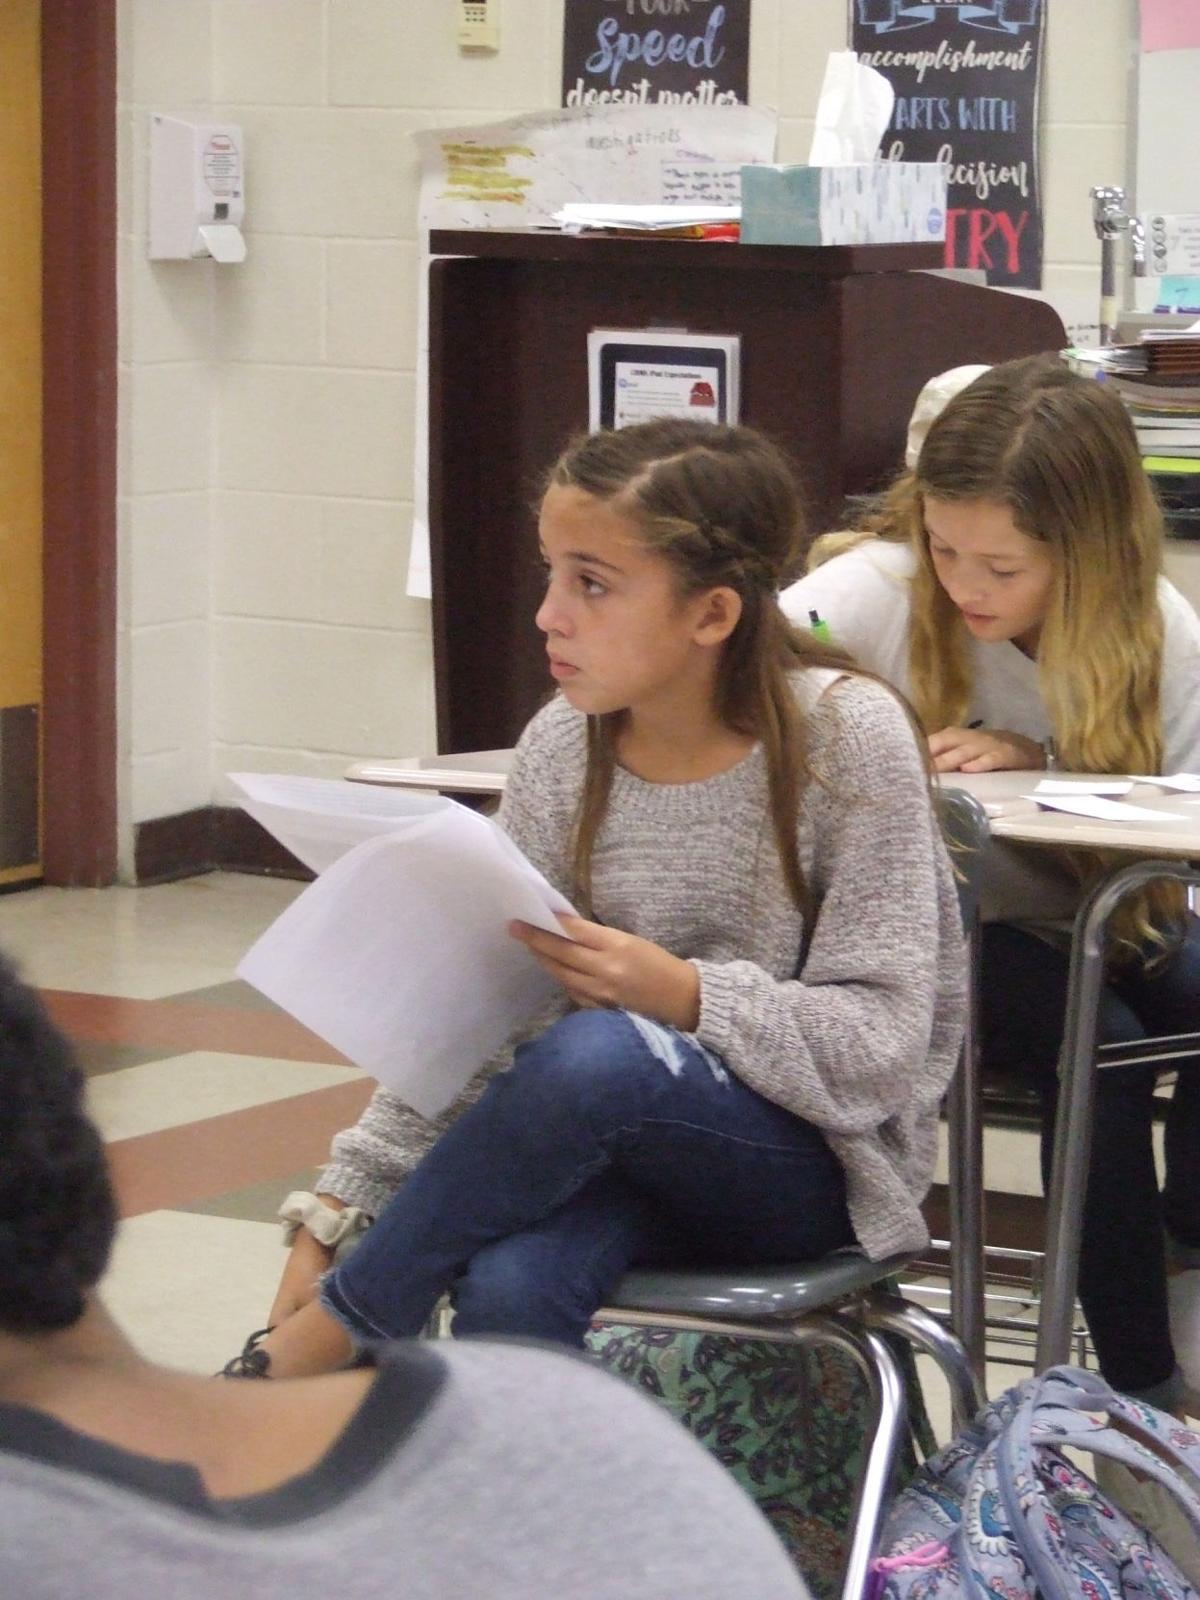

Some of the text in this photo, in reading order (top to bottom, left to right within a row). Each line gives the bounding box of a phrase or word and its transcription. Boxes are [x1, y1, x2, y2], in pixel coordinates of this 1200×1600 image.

[585, 4, 726, 87] Speed
[858, 39, 1032, 84] accomplishment
[657, 79, 740, 106] matter
[888, 97, 1017, 133] ARTS WITH
[944, 208, 1029, 274] TRY
